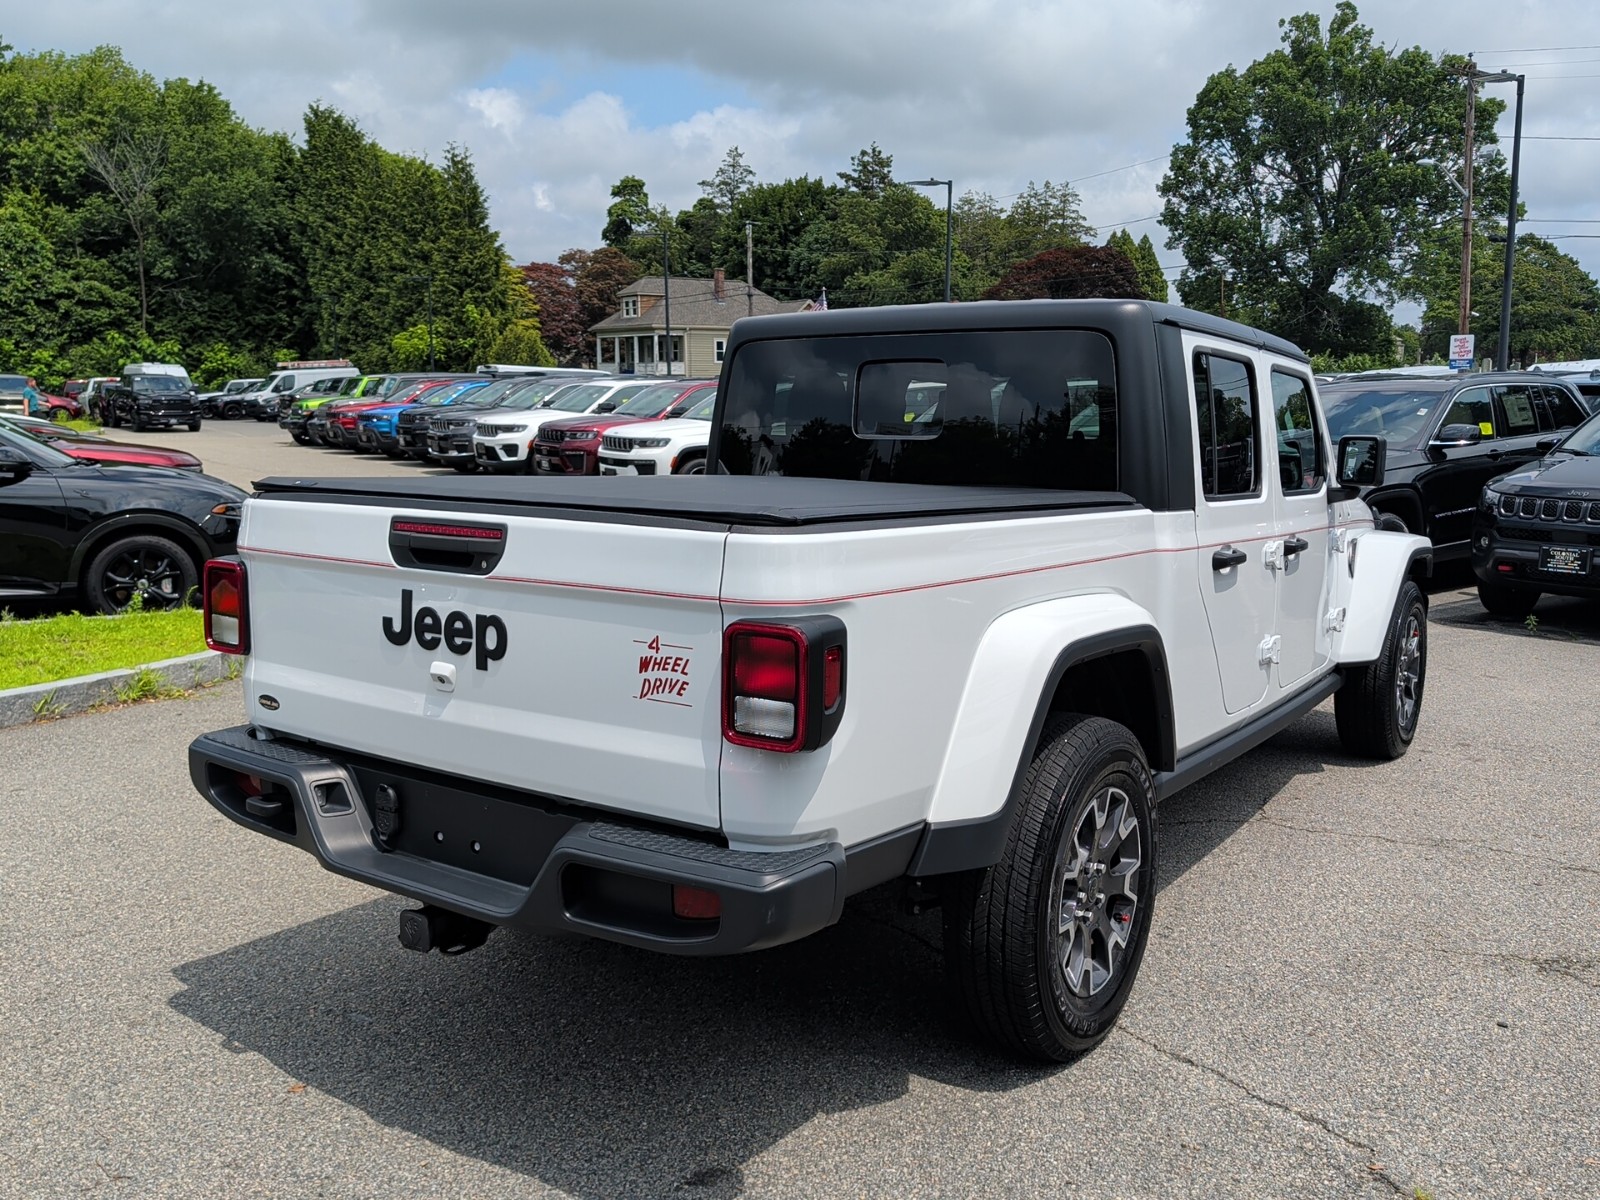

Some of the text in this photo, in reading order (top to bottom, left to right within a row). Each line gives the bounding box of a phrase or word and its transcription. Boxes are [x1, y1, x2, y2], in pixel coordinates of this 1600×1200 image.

[1550, 550, 1580, 558] COLONIAL
[382, 589, 508, 671] Jeep
[648, 635, 660, 654] 4
[639, 655, 690, 676] WHEEL
[639, 678, 690, 699] DRIVE
